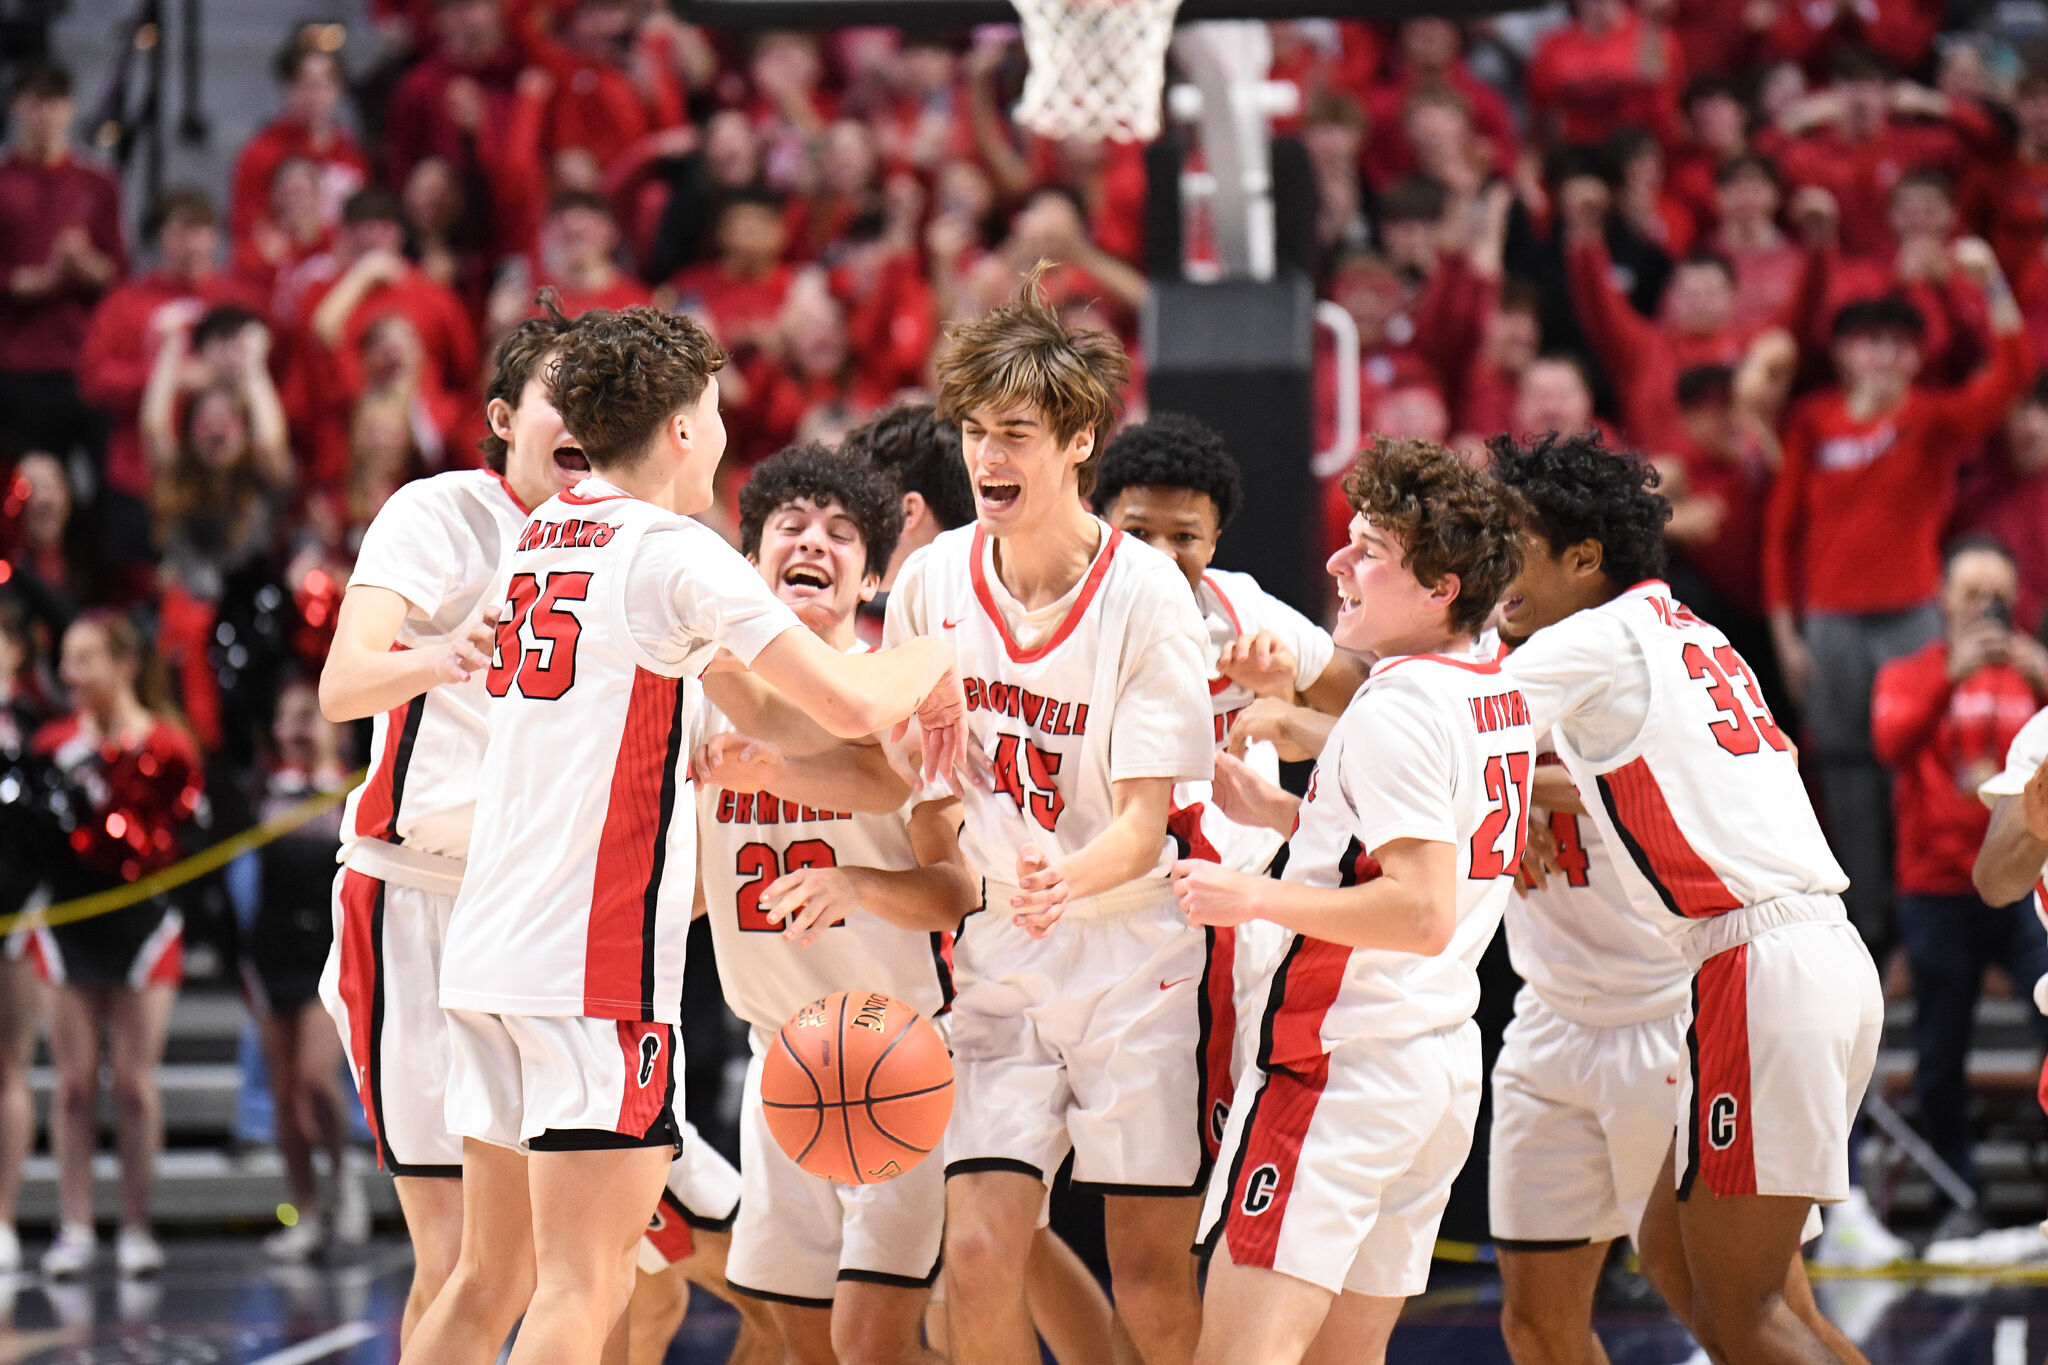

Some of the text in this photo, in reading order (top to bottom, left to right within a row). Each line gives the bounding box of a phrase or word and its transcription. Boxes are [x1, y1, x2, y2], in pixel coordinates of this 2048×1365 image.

[486, 570, 594, 701] 35
[963, 677, 1090, 736] CROMWELL
[1682, 642, 1790, 757] 33
[993, 731, 1066, 833] 45
[1469, 750, 1529, 880] 27
[1520, 811, 1591, 888] 4
[1708, 1092, 1738, 1151] C
[1241, 1163, 1281, 1217] C
